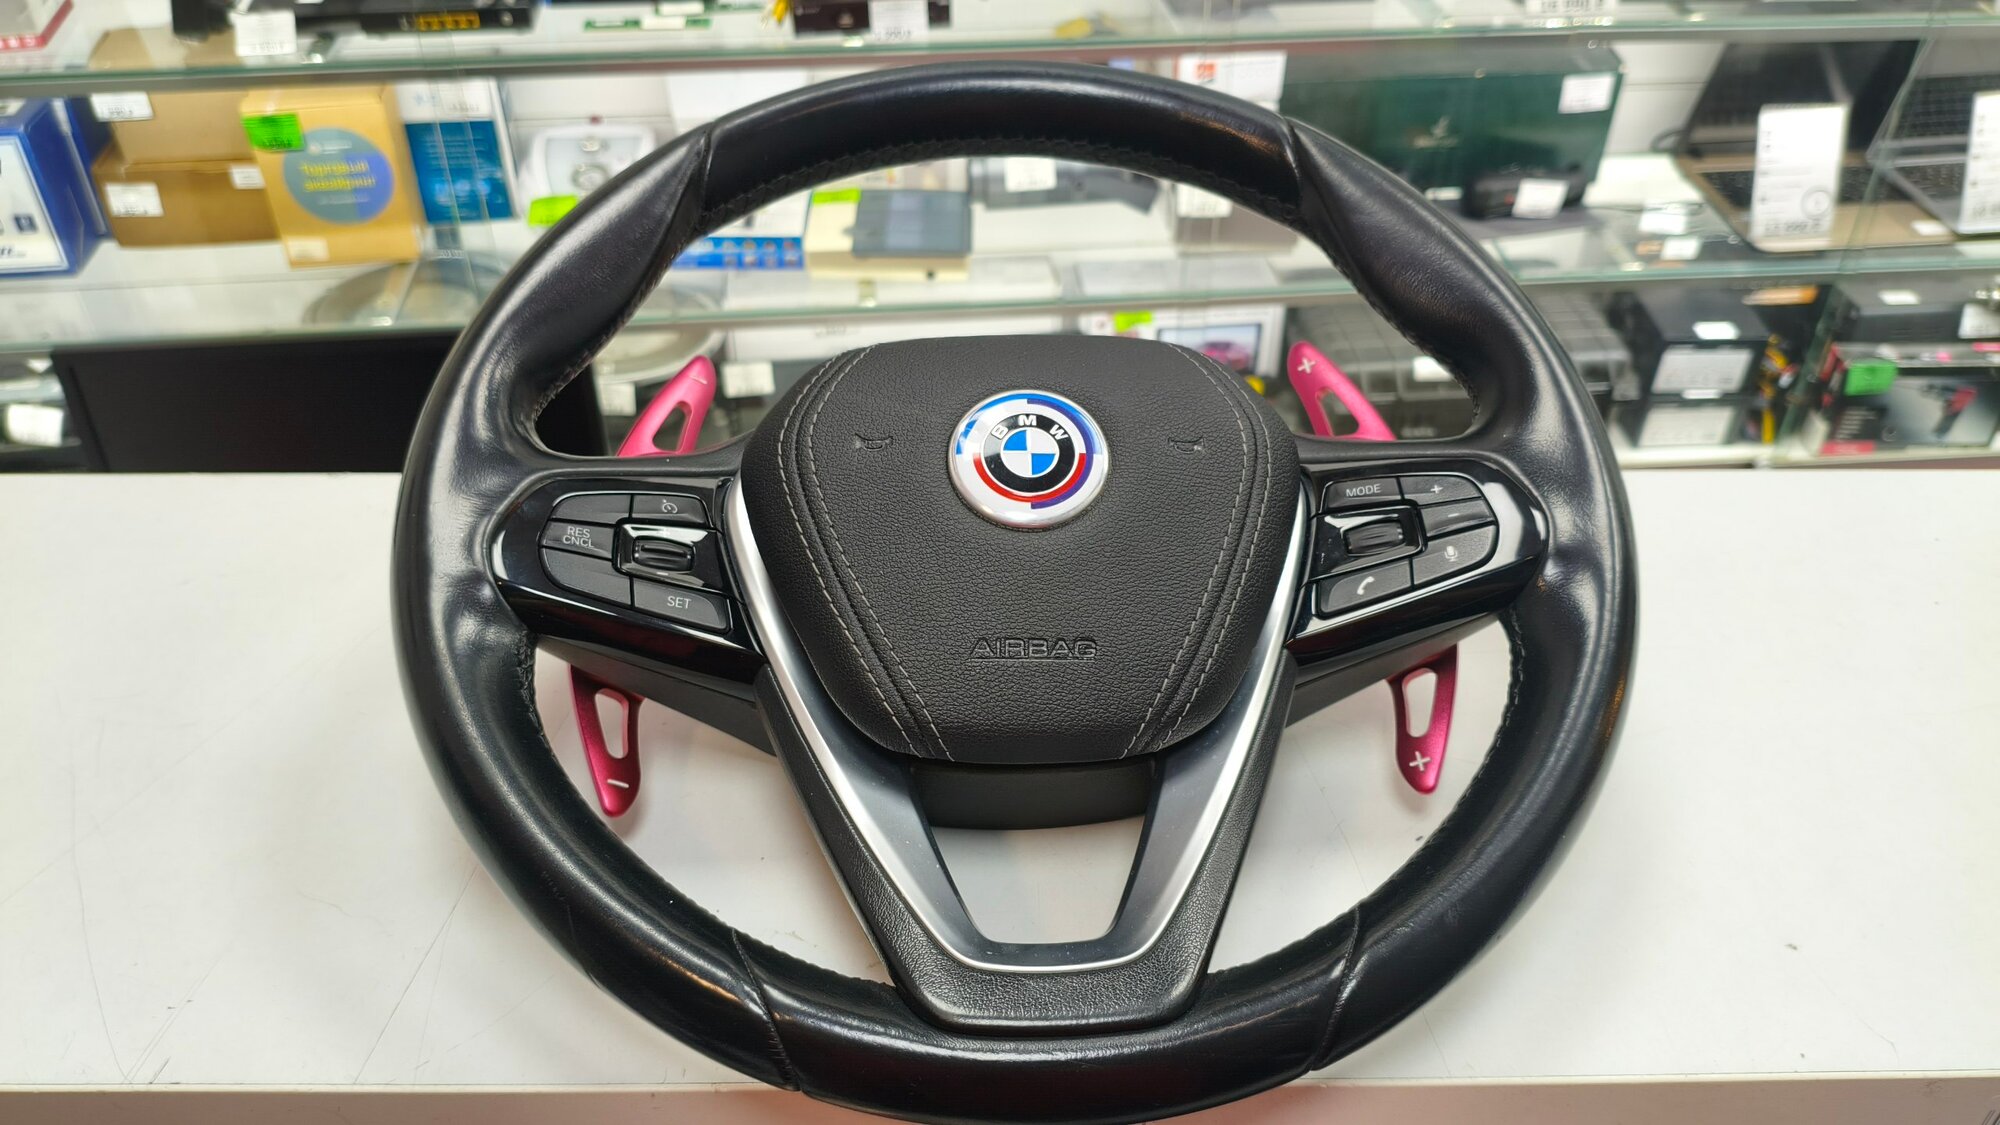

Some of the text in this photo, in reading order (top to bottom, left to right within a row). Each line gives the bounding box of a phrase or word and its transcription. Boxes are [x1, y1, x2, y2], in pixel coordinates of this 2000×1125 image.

[990, 414, 1069, 440] BMW
[1345, 484, 1382, 497] MODE
[567, 525, 591, 539] RES
[562, 534, 595, 549] CNCL
[666, 595, 692, 610] SET
[971, 637, 1098, 659] AIRBAG
